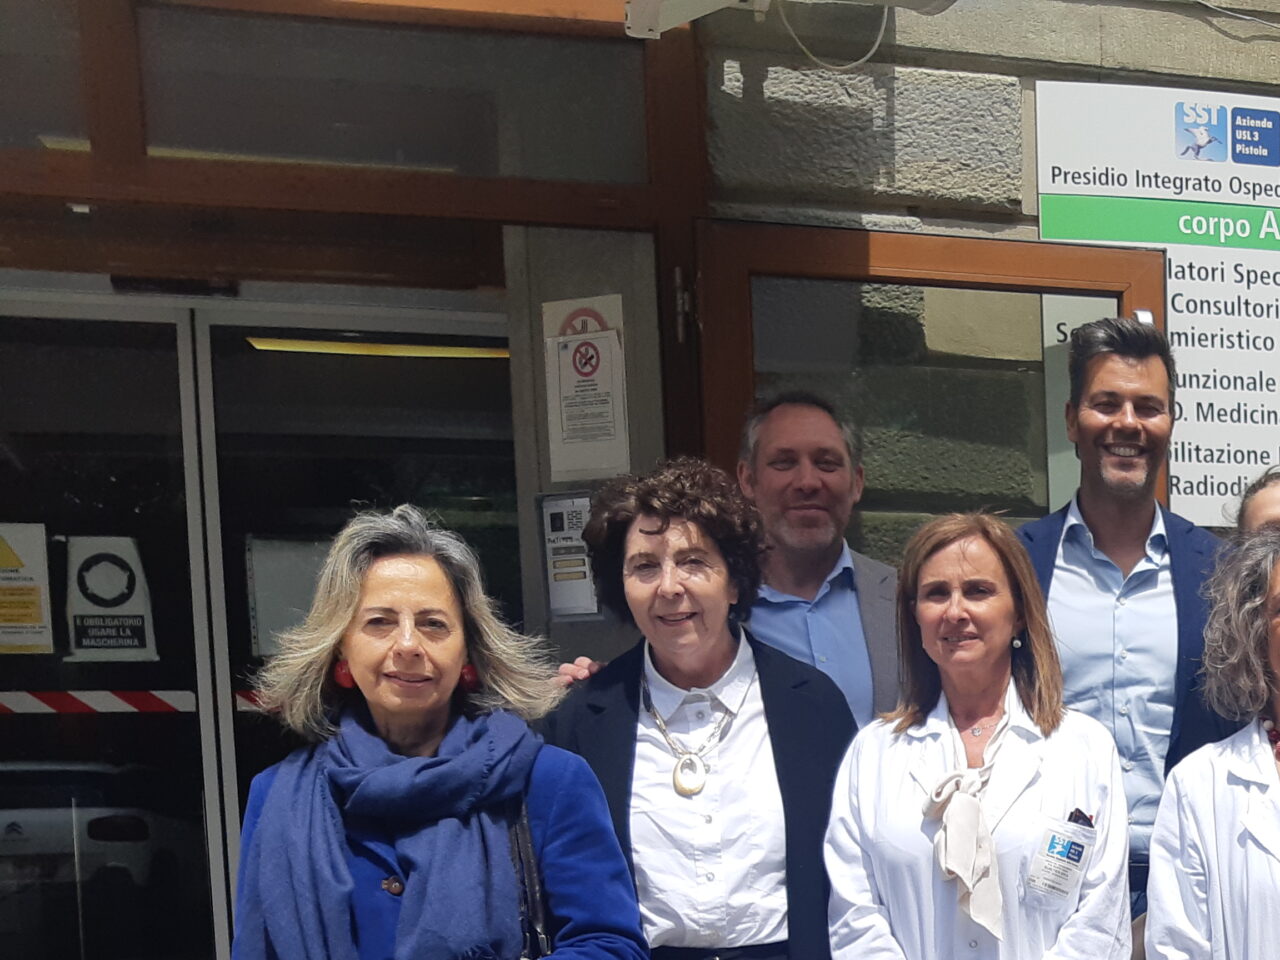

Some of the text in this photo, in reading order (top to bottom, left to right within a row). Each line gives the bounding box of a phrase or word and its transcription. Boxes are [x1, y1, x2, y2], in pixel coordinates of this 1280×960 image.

[1183, 102, 1220, 126] SST
[1235, 116, 1273, 129] Azienda
[1235, 129, 1260, 142] USL 3
[1235, 143, 1269, 157] Pistoia
[1051, 165, 1128, 188] Presidio
[1135, 169, 1222, 195] Integrato
[1178, 214, 1250, 243] corpo
[1168, 258, 1225, 283] latori
[1170, 326, 1275, 352] mieristico
[1175, 369, 1276, 393] unzionale
[1170, 441, 1271, 466] ilitazione
[82, 637, 139, 647] MASCHERINA
[119, 627, 132, 637] LA
